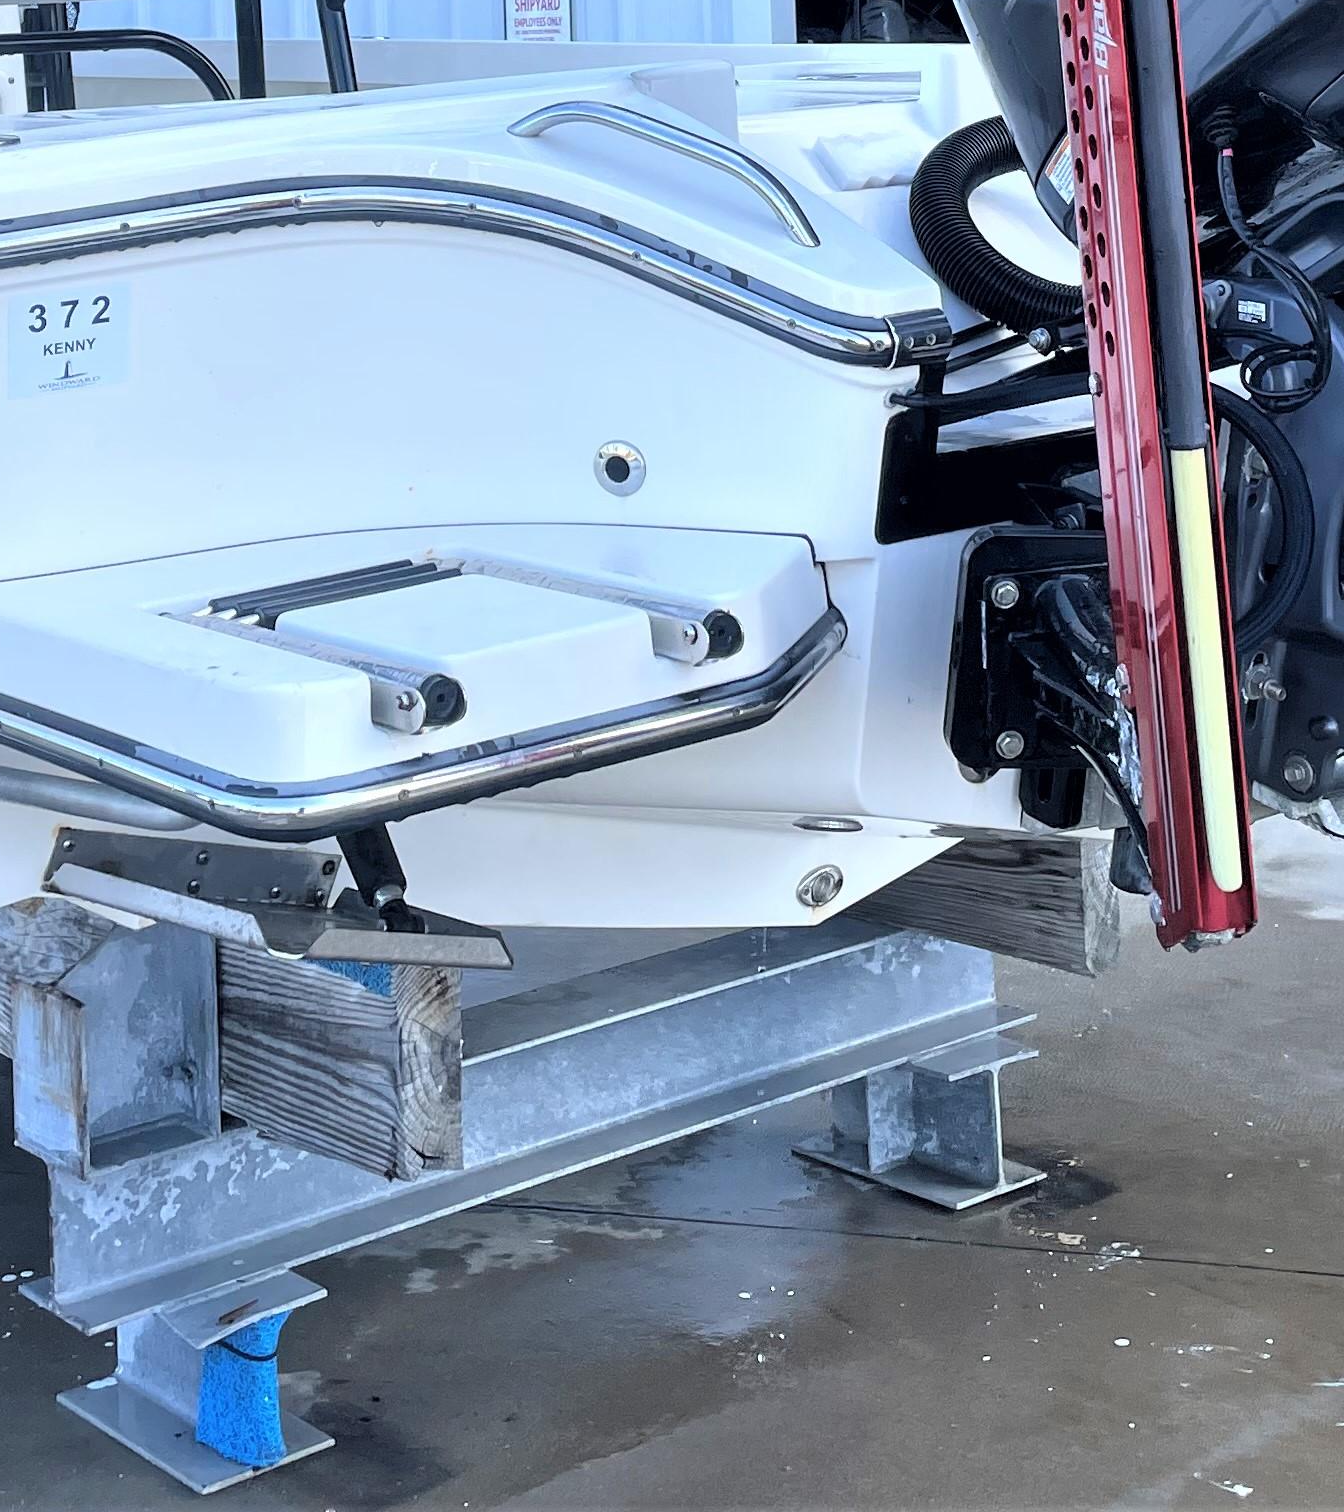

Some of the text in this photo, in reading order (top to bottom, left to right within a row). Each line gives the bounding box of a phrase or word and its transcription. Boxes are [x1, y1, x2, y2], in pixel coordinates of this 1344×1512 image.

[514, 16, 562, 28] EMPLOYEES ONLY
[43, 338, 96, 356] KENNY
